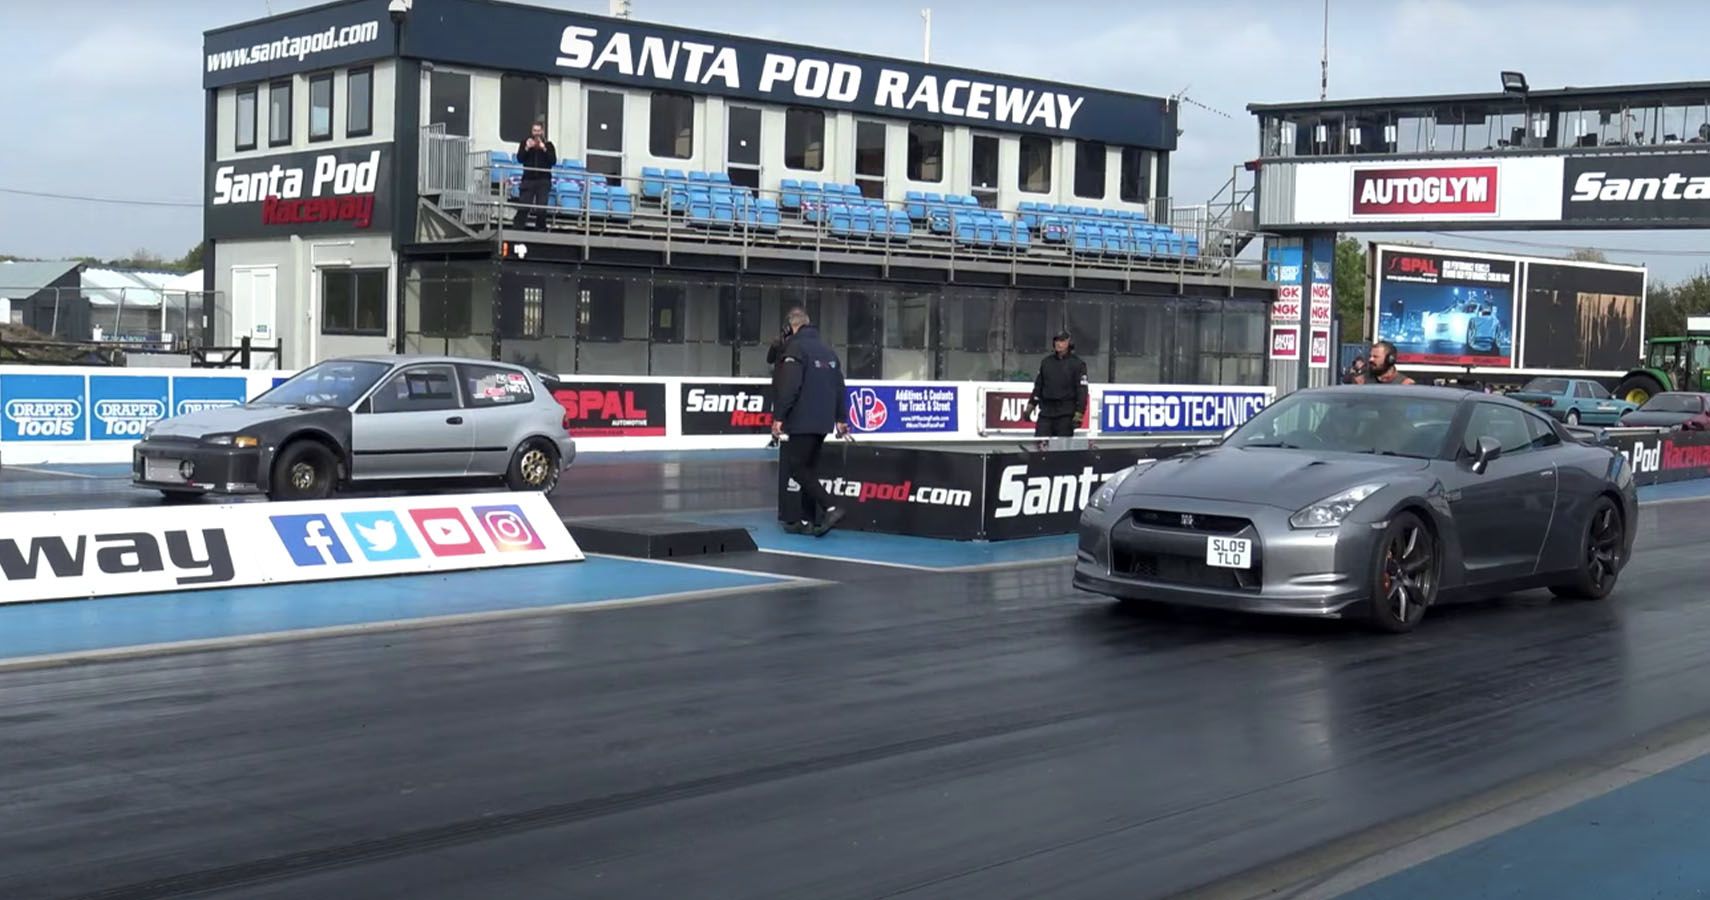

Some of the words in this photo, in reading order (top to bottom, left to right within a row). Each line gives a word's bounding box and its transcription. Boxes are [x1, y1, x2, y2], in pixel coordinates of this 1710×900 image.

[207, 19, 379, 73] www.santapod.com
[556, 25, 740, 88] SANTA
[759, 53, 862, 102] POD
[874, 69, 1084, 130] RACEWAY
[213, 165, 303, 205] Santa
[312, 150, 381, 197] Pod
[1360, 176, 1488, 205] AUTOGLYM
[1570, 172, 1710, 201] Santa
[262, 193, 374, 228] Raceway
[1400, 257, 1438, 273] SPAL
[1313, 286, 1330, 299] NGK
[1273, 304, 1299, 315] NGK
[1312, 306, 1329, 320] NGK
[13, 403, 74, 416] DRAPER
[101, 403, 158, 416] DRAPER
[554, 390, 647, 419] SPAL
[686, 389, 764, 412] Santa
[1104, 395, 1180, 428] TURBO
[1181, 396, 1263, 428] TECHNICS
[16, 417, 74, 436] Tools
[104, 417, 153, 435] Tool
[1632, 439, 1661, 473] Pod
[995, 464, 1115, 518] Sant
[0, 528, 235, 585] way
[1213, 539, 1246, 553] SL09
[1217, 552, 1241, 565] TLO
